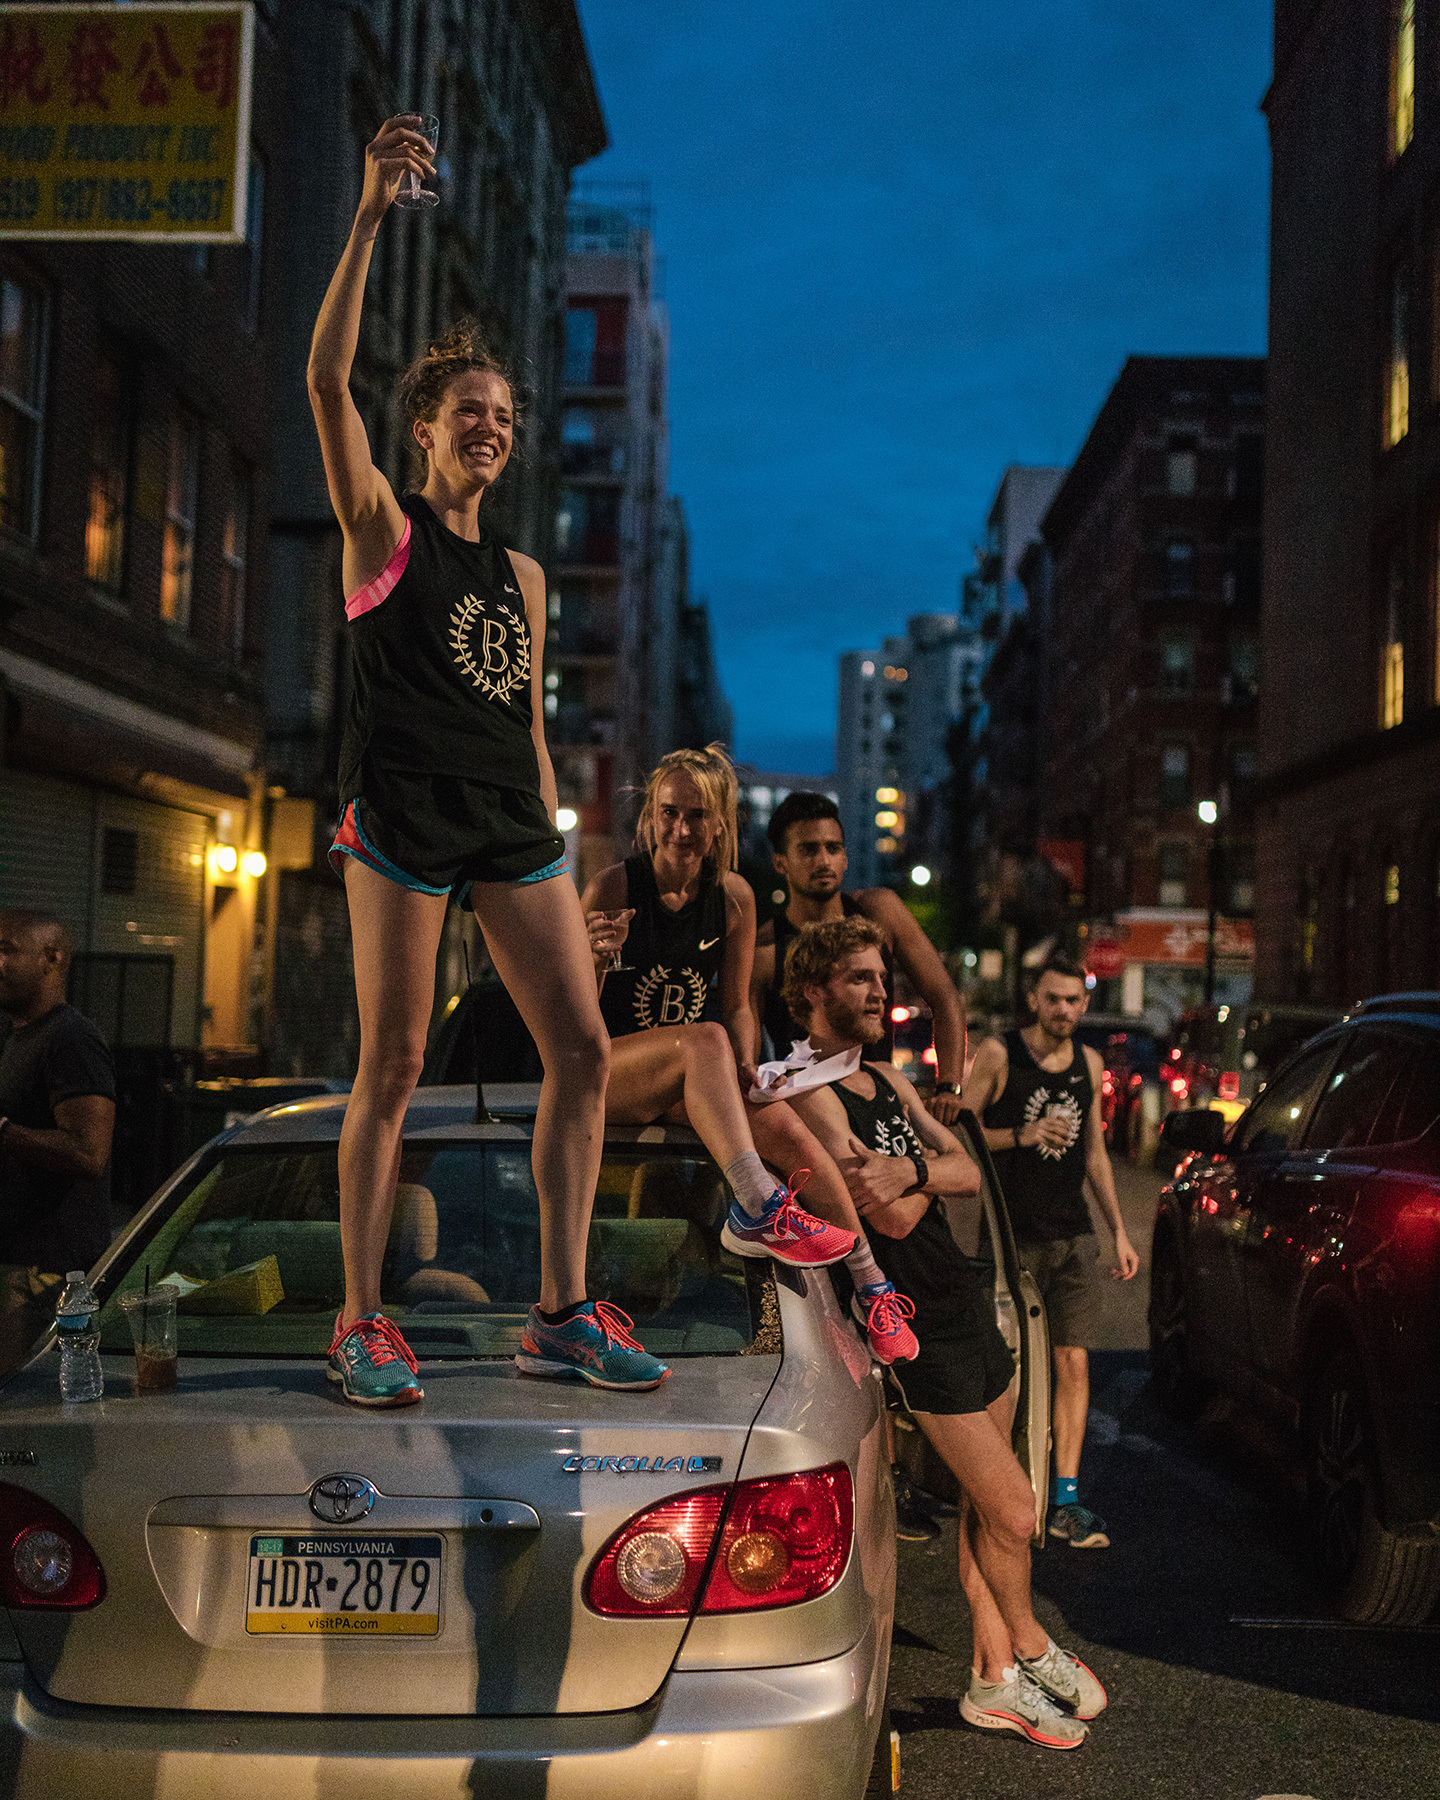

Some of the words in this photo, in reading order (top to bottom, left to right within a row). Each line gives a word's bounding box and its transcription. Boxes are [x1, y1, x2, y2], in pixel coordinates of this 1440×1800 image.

[482, 618, 509, 673] B
[660, 984, 686, 1023] B
[562, 1455, 685, 1473] COROLLA
[298, 1542, 395, 1554] PENNSYLVANIA
[308, 1617, 379, 1630] visitPA.com
